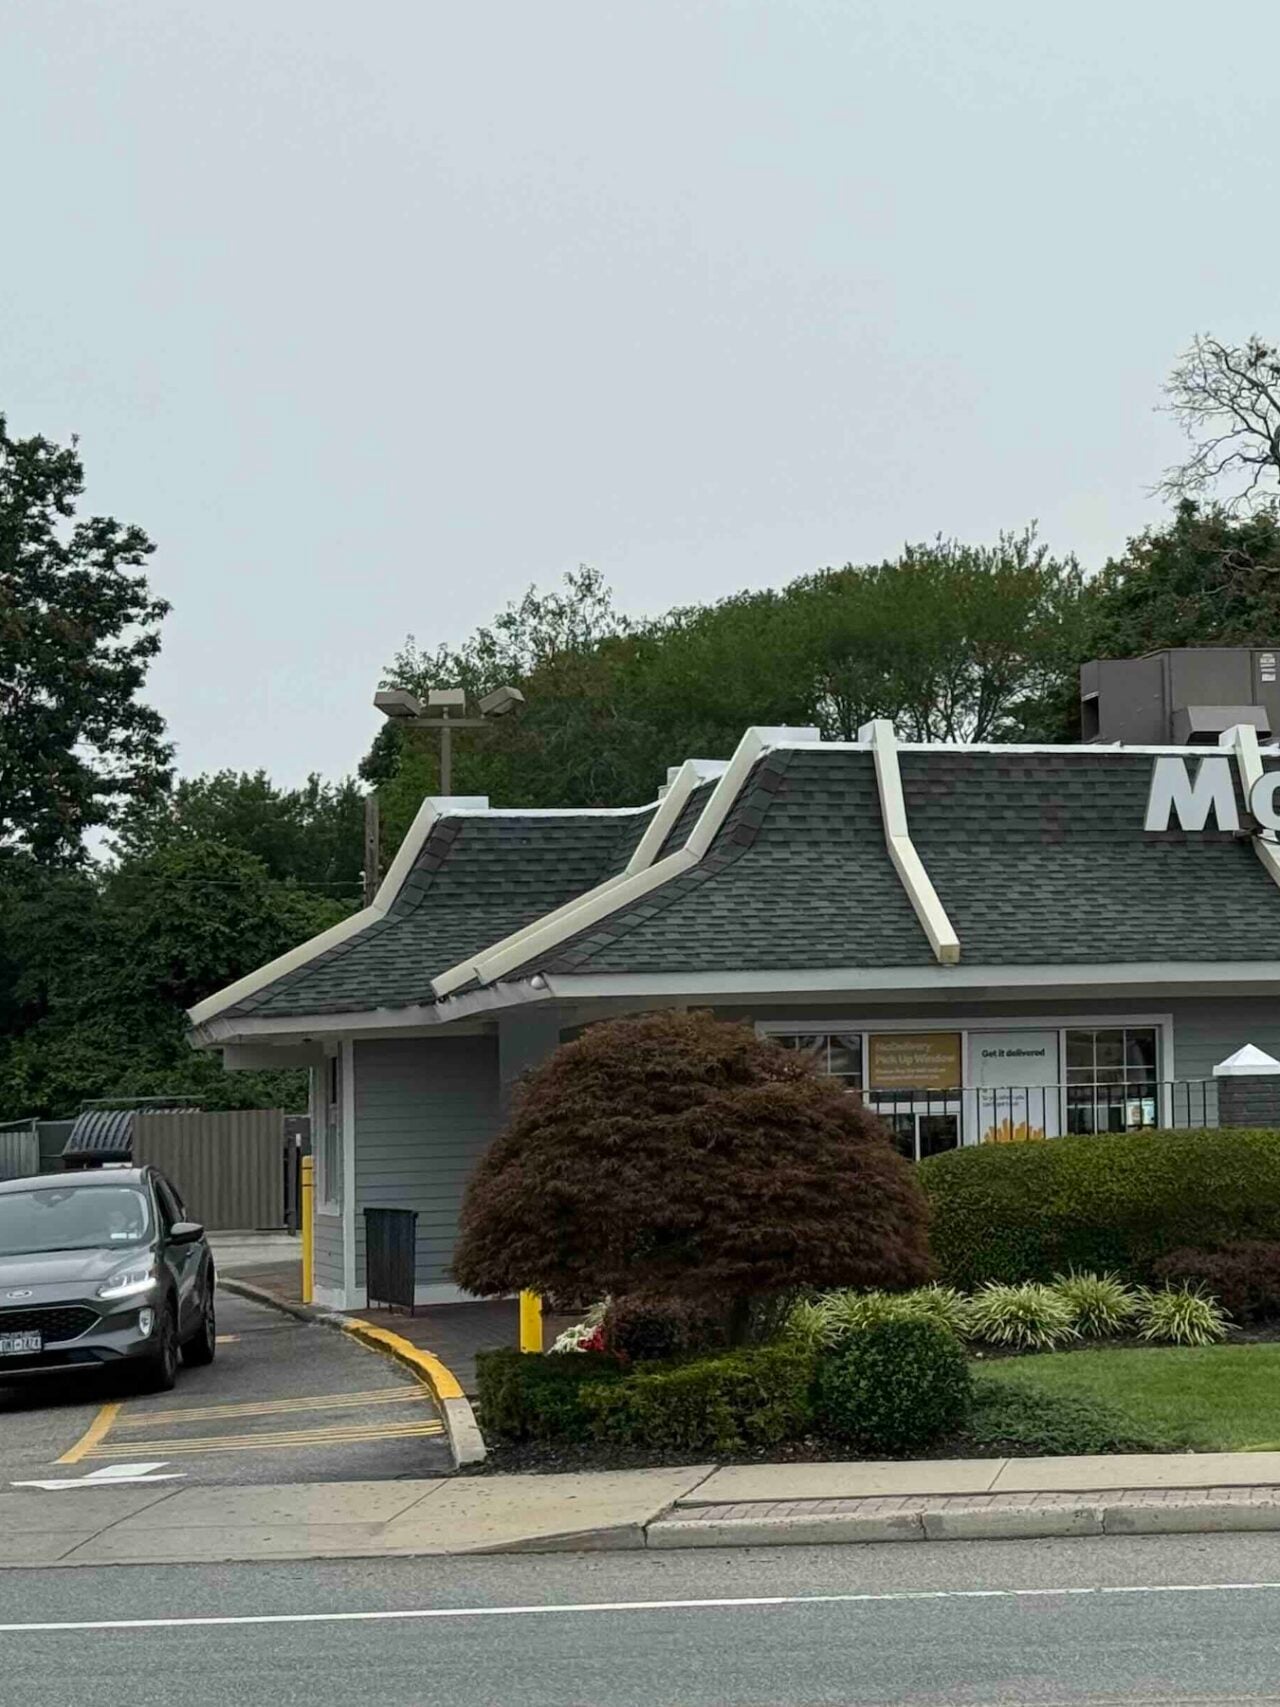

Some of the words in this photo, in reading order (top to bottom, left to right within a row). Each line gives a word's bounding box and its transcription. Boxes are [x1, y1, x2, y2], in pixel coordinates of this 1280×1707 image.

[981, 1049, 997, 1057] Get
[998, 1049, 1005, 1057] it
[1006, 1048, 1045, 1057] delivered
